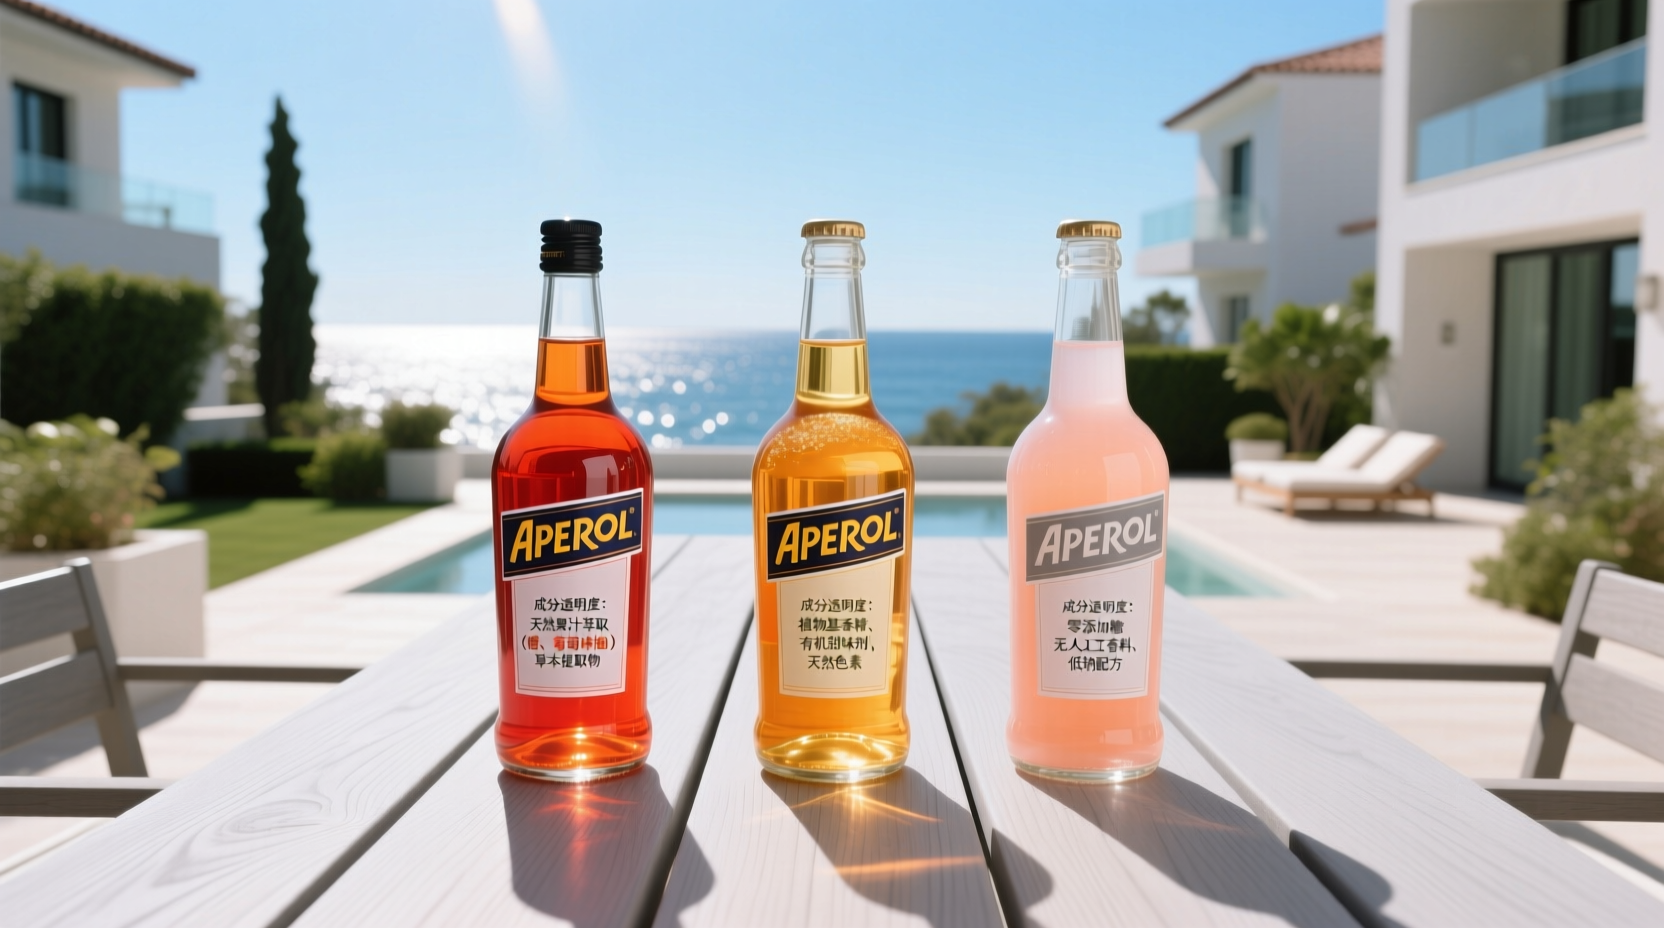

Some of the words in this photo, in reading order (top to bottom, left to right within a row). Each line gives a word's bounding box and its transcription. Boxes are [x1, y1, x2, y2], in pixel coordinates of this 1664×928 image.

[509, 510, 633, 563] APEROL
[775, 511, 897, 565] APEROL
[1034, 513, 1157, 567] APEROL
